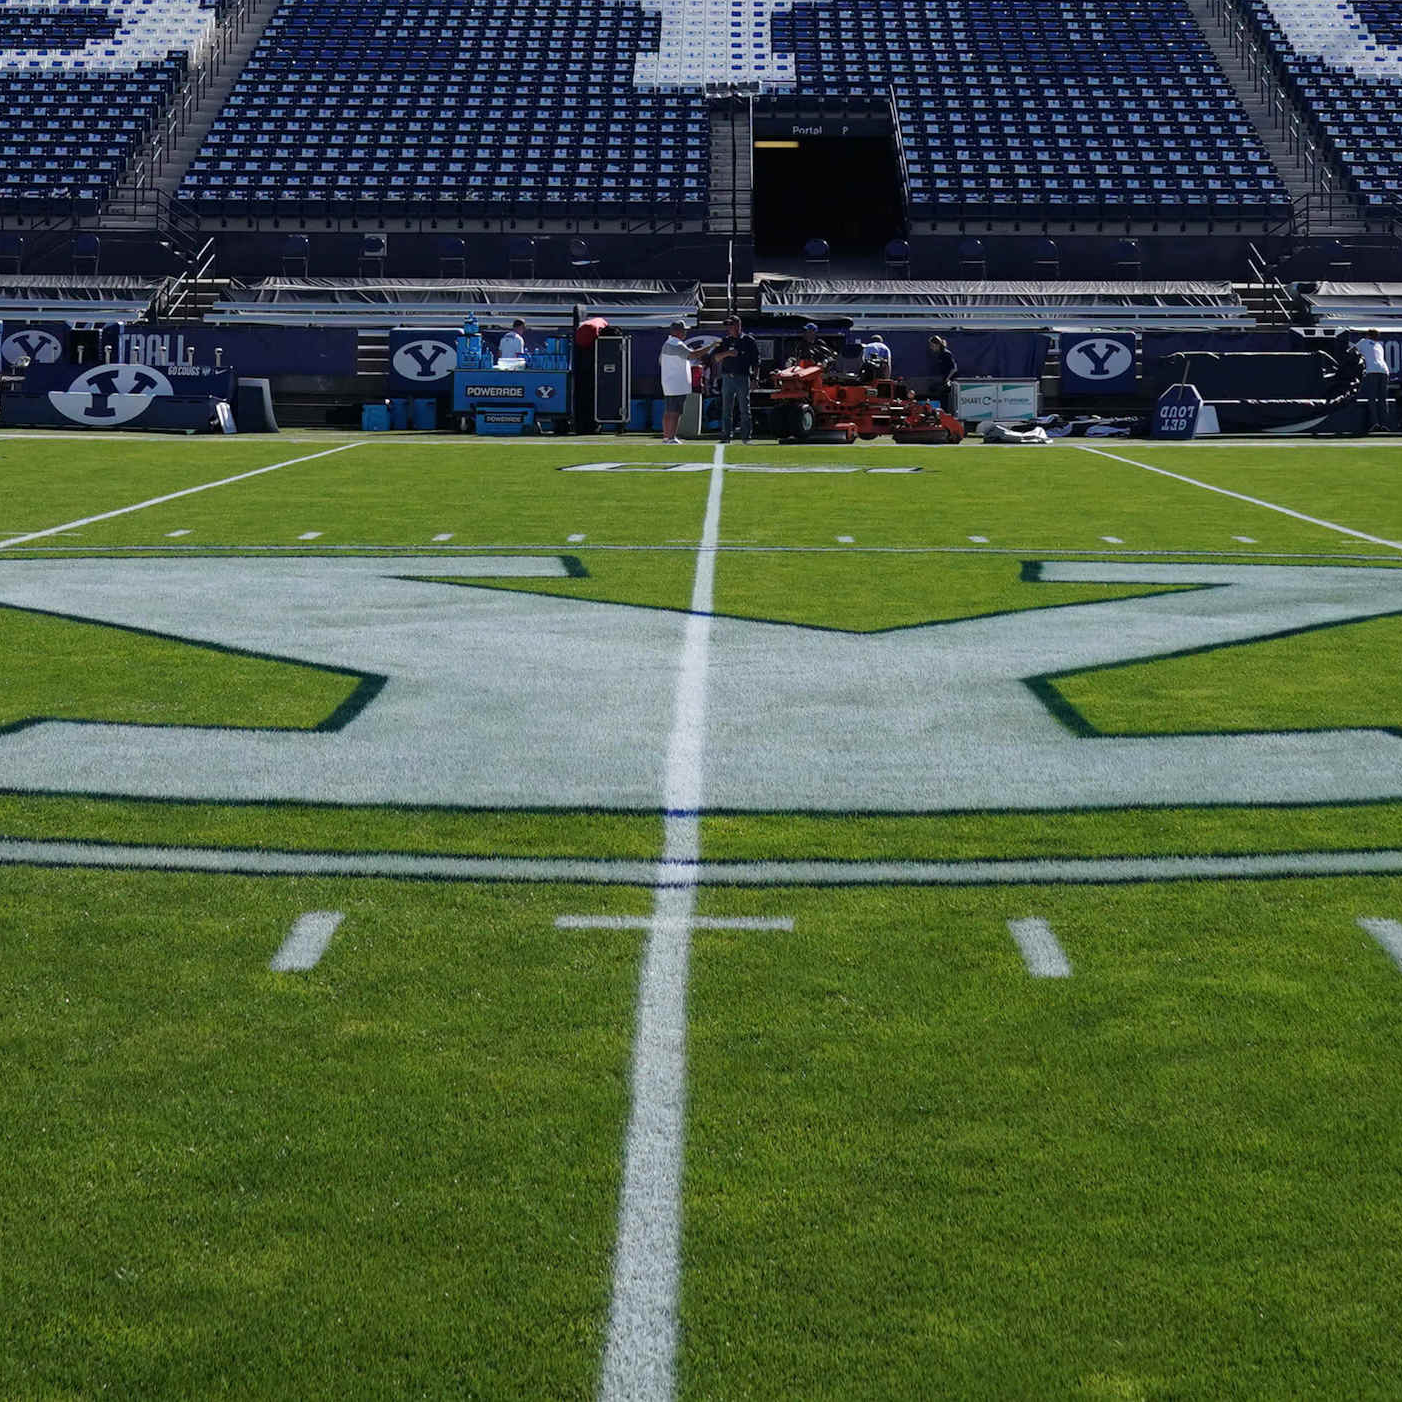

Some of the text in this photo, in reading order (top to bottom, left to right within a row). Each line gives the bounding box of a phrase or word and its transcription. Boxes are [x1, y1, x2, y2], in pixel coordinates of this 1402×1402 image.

[792, 125, 849, 135] Portal P
[168, 366, 177, 376] GO
[467, 386, 523, 397] POWERADE
[1160, 405, 1195, 418] LOUD
